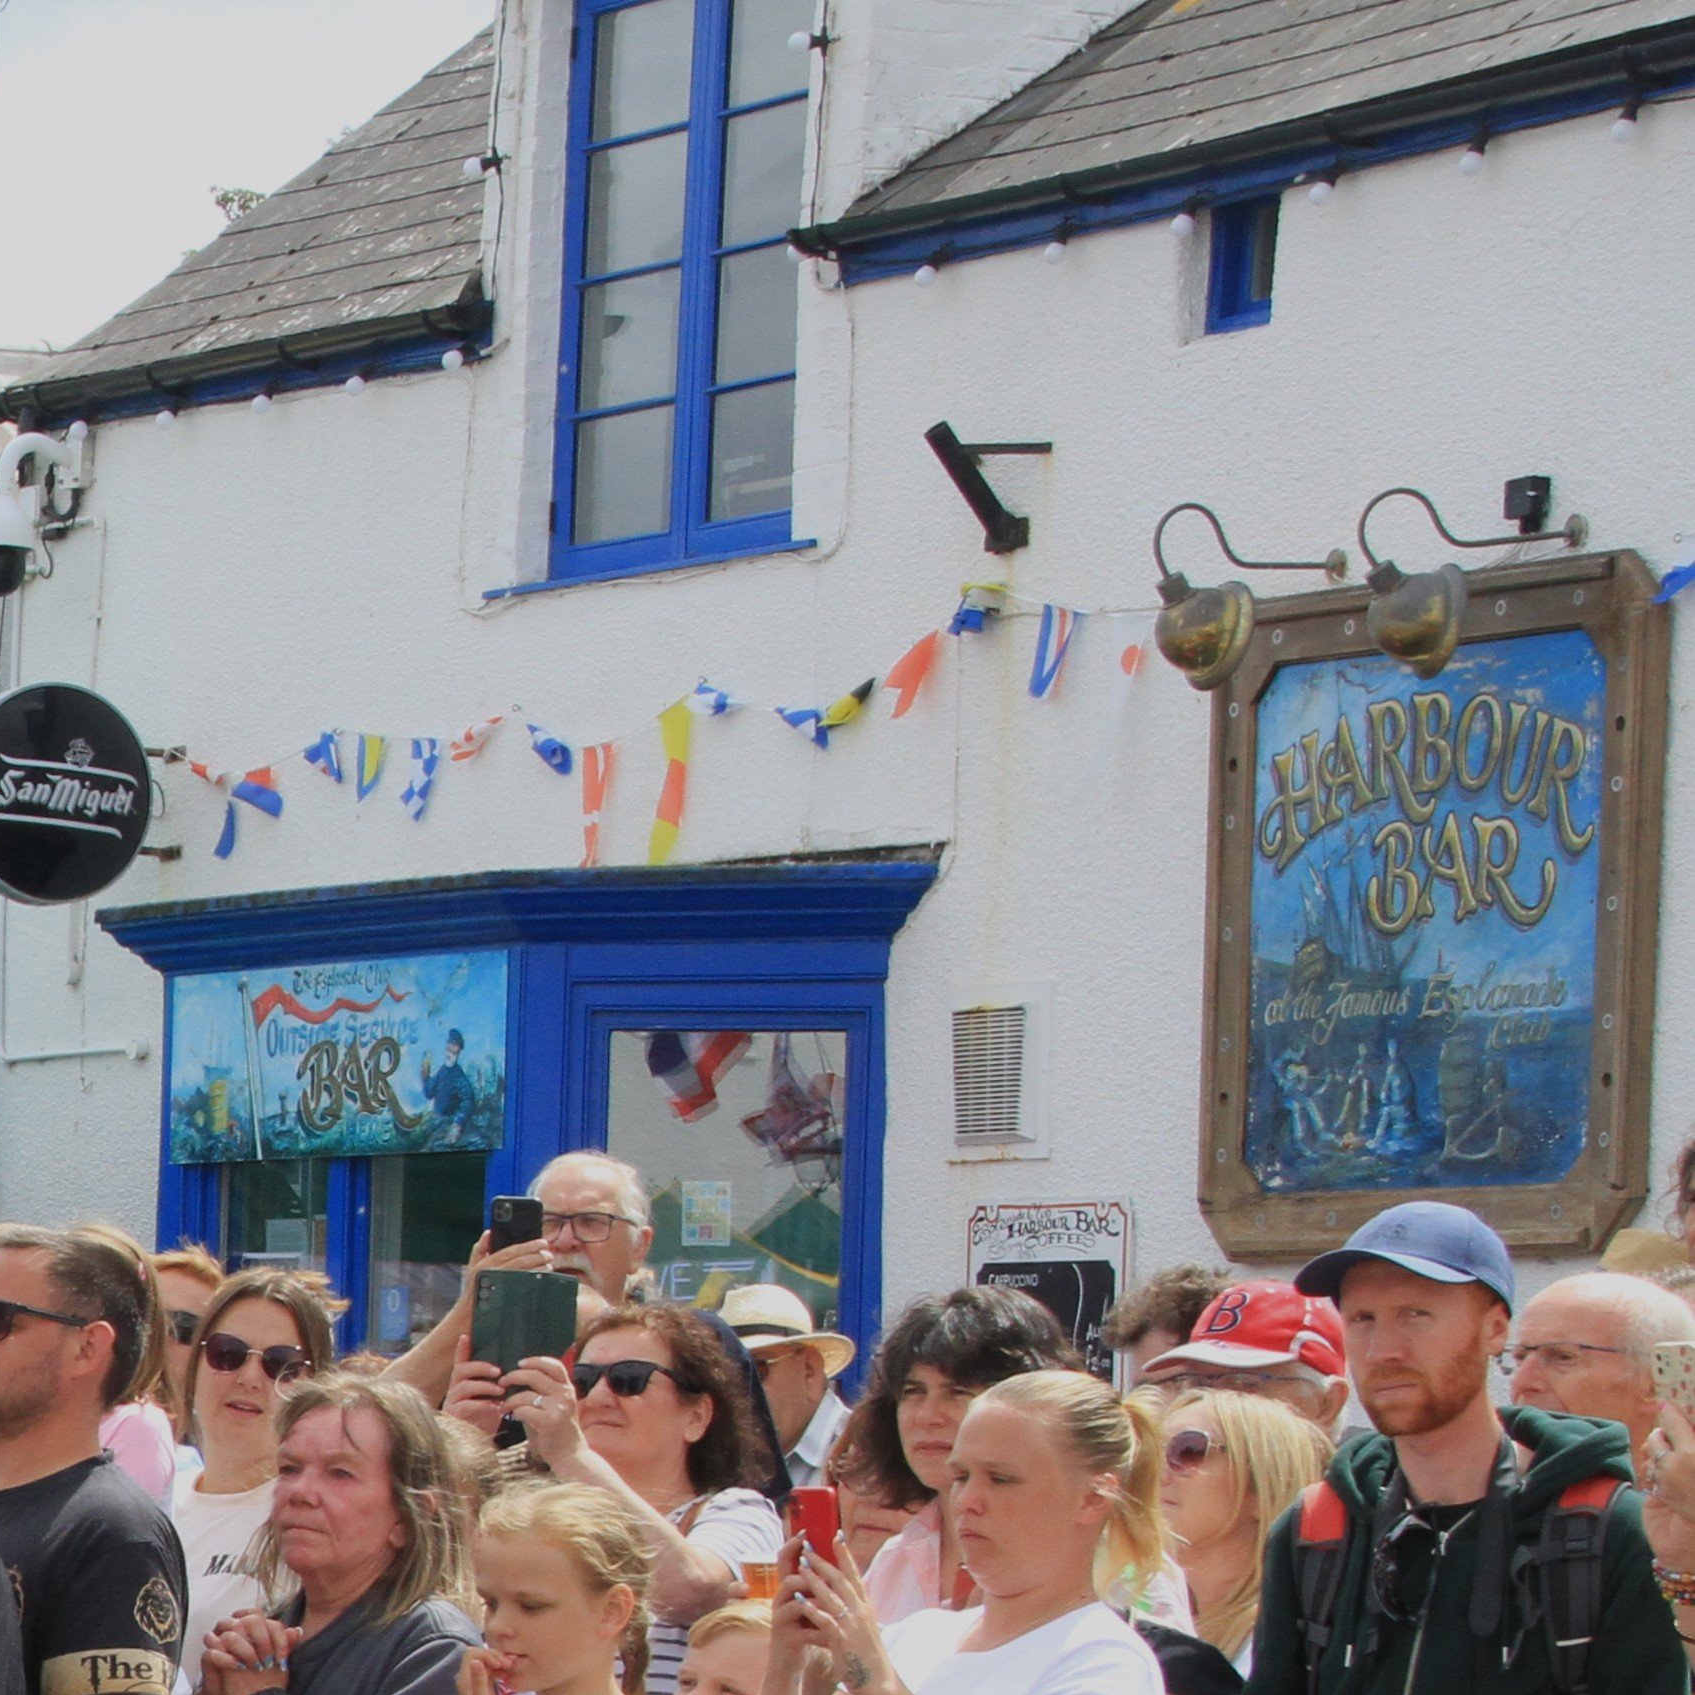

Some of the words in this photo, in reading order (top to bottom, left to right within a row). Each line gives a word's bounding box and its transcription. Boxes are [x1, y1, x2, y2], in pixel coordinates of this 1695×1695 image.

[1261, 690, 1595, 875] HARBOUR
[1366, 810, 1557, 935] BAR
[1264, 987, 1288, 1026] at
[1293, 980, 1323, 1021] the
[1418, 960, 1569, 1034] Esplanade
[1488, 1015, 1555, 1050] Club
[296, 1035, 423, 1133] BAR
[1007, 1216, 1070, 1239] HARBOUR
[1059, 1209, 1120, 1237] BAR
[1023, 1231, 1096, 1250] COFFEES
[1203, 1291, 1250, 1334] B
[80, 1653, 154, 1695] The
